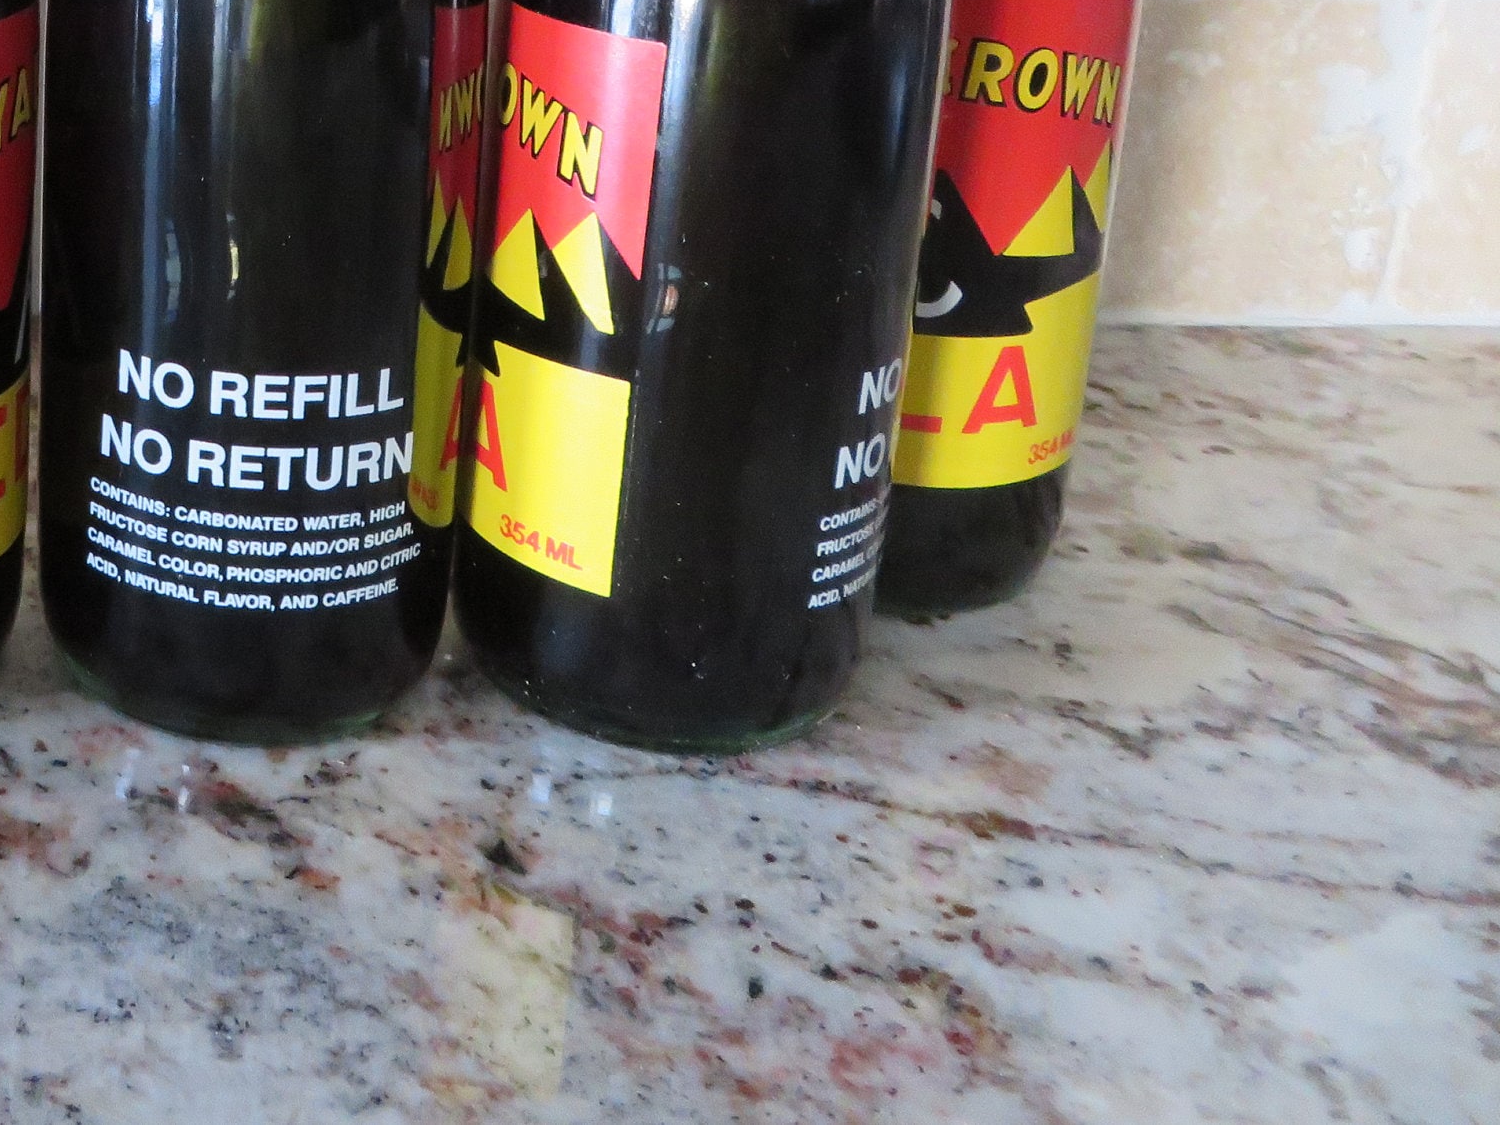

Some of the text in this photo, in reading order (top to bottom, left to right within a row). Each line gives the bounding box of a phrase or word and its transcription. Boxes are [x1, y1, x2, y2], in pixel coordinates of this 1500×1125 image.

[118, 348, 404, 420] NO REFILL
[858, 358, 902, 415] NO
[100, 413, 414, 491] NO RETURN
[834, 433, 886, 490] NO
[89, 501, 168, 543] FRUCTOSE
[171, 531, 223, 552] CORN
[226, 540, 287, 556] SYRUP
[290, 537, 360, 556] AND/OR
[90, 477, 405, 532] CONTAINS: CARBONATED WATER, HIGH
[88, 527, 421, 583] CARAMEL COLOR, PHOSPHORIC AND CITRIC
[500, 514, 583, 571] 354 ML
[87, 552, 399, 612] ACID, NATURAL FLAVOR, AND CAFFEINE.
